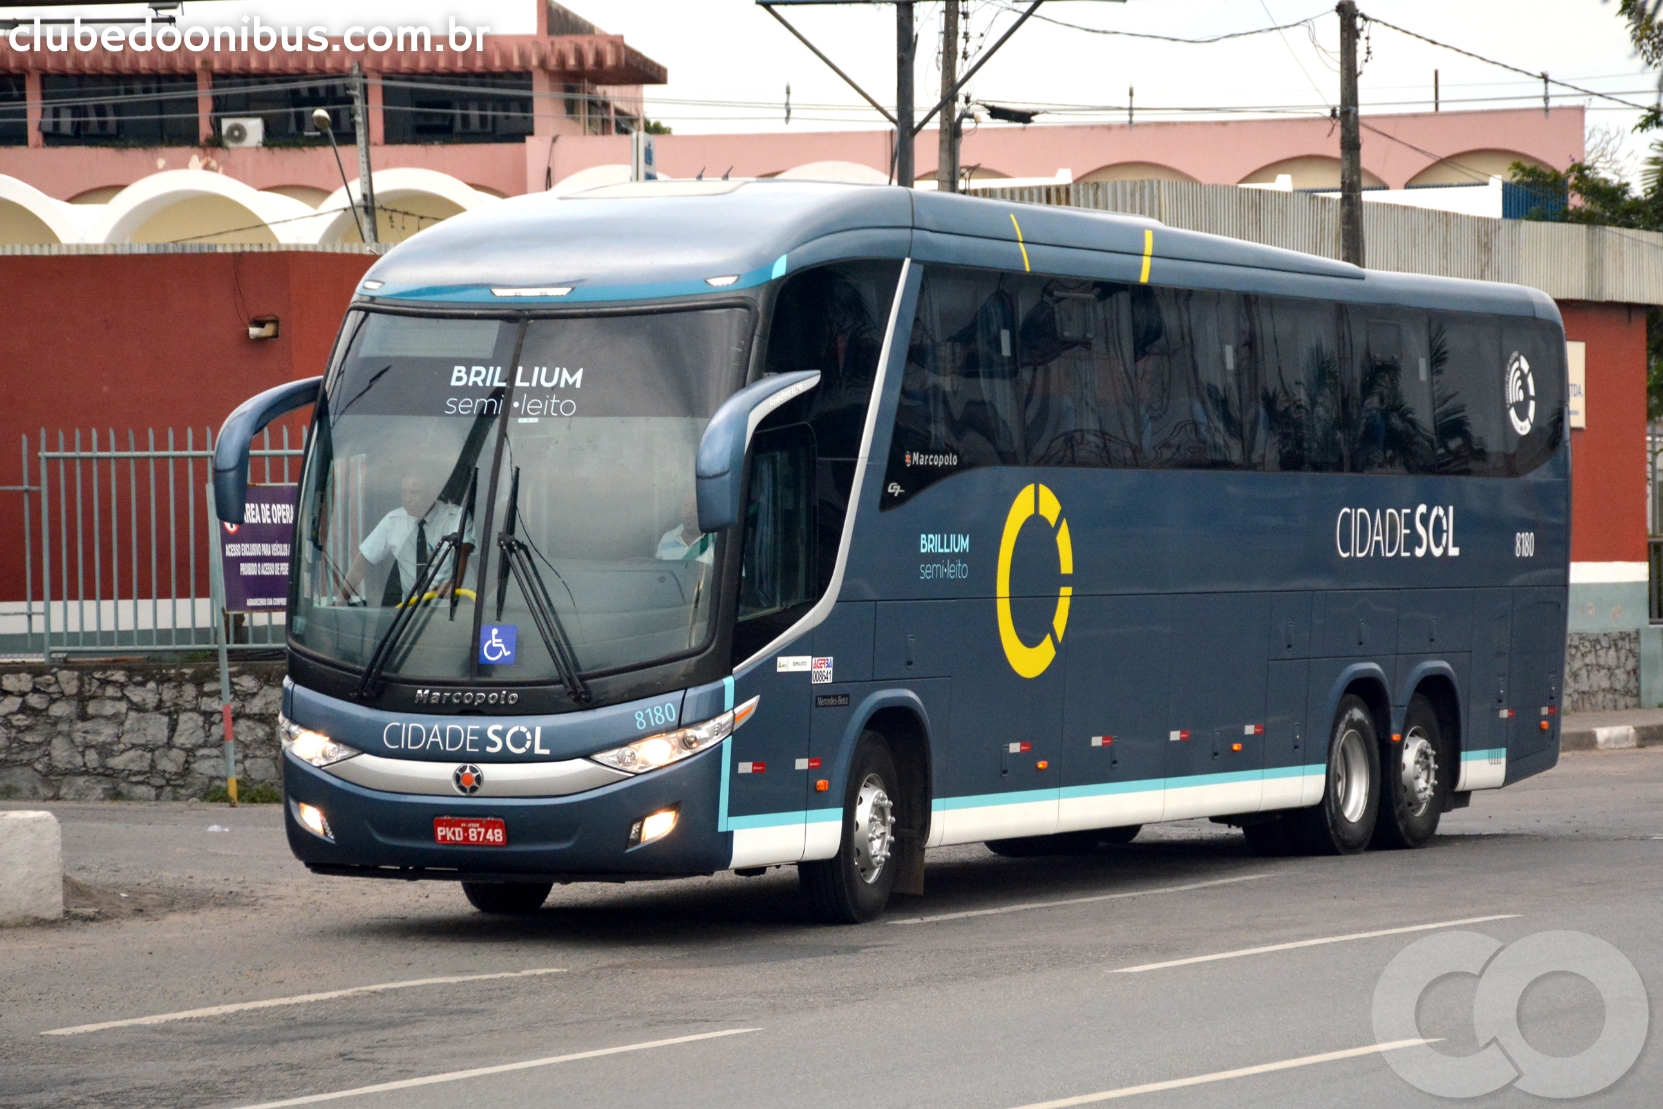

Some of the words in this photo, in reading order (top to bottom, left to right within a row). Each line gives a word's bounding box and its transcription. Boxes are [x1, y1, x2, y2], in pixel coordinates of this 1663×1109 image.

[912, 451, 958, 467] Marcopolo
[244, 503, 260, 523] REA
[260, 503, 271, 524] DE
[1336, 507, 1411, 558] CIDADE
[1414, 503, 1460, 558] SOL
[225, 543, 240, 557] ACESSO
[241, 543, 261, 556] EXCLUSIVO
[262, 543, 271, 556] PARA
[920, 533, 970, 553] BRILLIUM
[1515, 532, 1535, 557] 8180
[812, 670, 832, 682] 008641
[414, 689, 519, 706] Marcopolo
[634, 702, 676, 730] 8180
[383, 722, 480, 751] CIDADE
[485, 724, 550, 755] SOL
